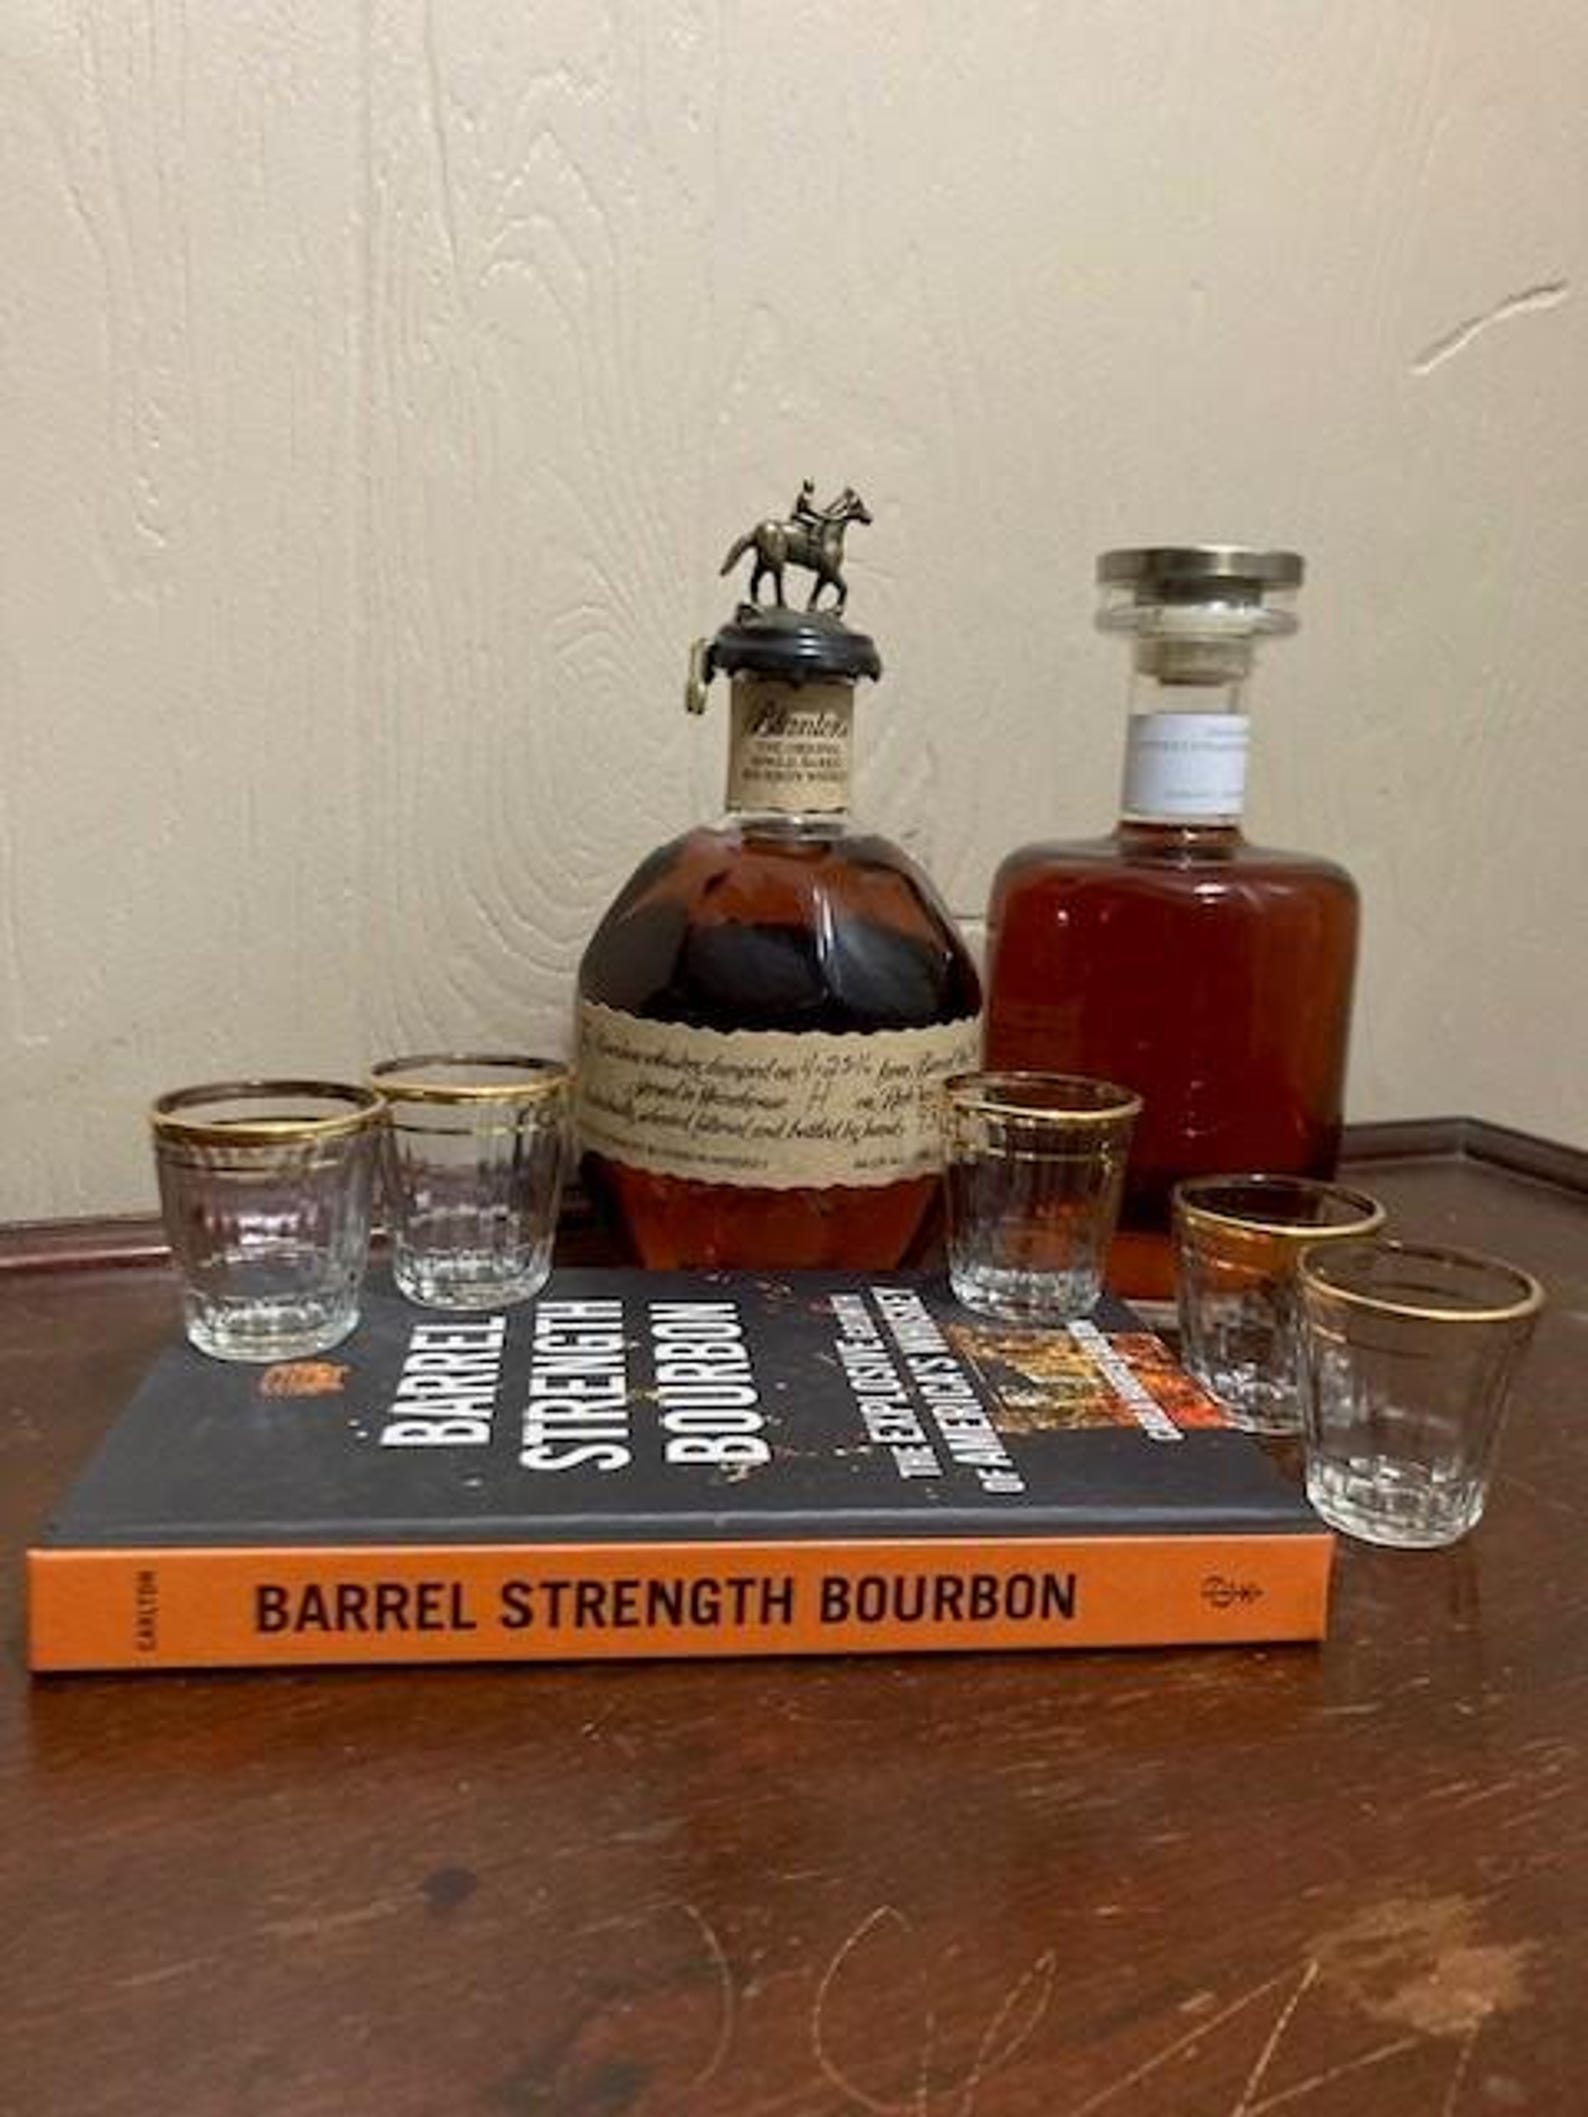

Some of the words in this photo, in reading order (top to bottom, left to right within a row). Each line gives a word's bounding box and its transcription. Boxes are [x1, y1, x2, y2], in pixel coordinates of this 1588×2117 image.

[870, 1286, 950, 1353] WHISKEY
[379, 1315, 506, 1447] BARREL
[519, 1300, 632, 1471] STRENGTH
[649, 1302, 771, 1464] BOURBON
[834, 1339, 928, 1442] EXPLOSIVE
[905, 1356, 1014, 1467] AMERICA'S
[889, 1445, 944, 1479] THE
[975, 1468, 1026, 1493] OF
[136, 1571, 159, 1651] CARLTON
[255, 1582, 477, 1634] BARREL
[500, 1576, 793, 1630] STRENGTH
[819, 1573, 1077, 1624] BOURBON
